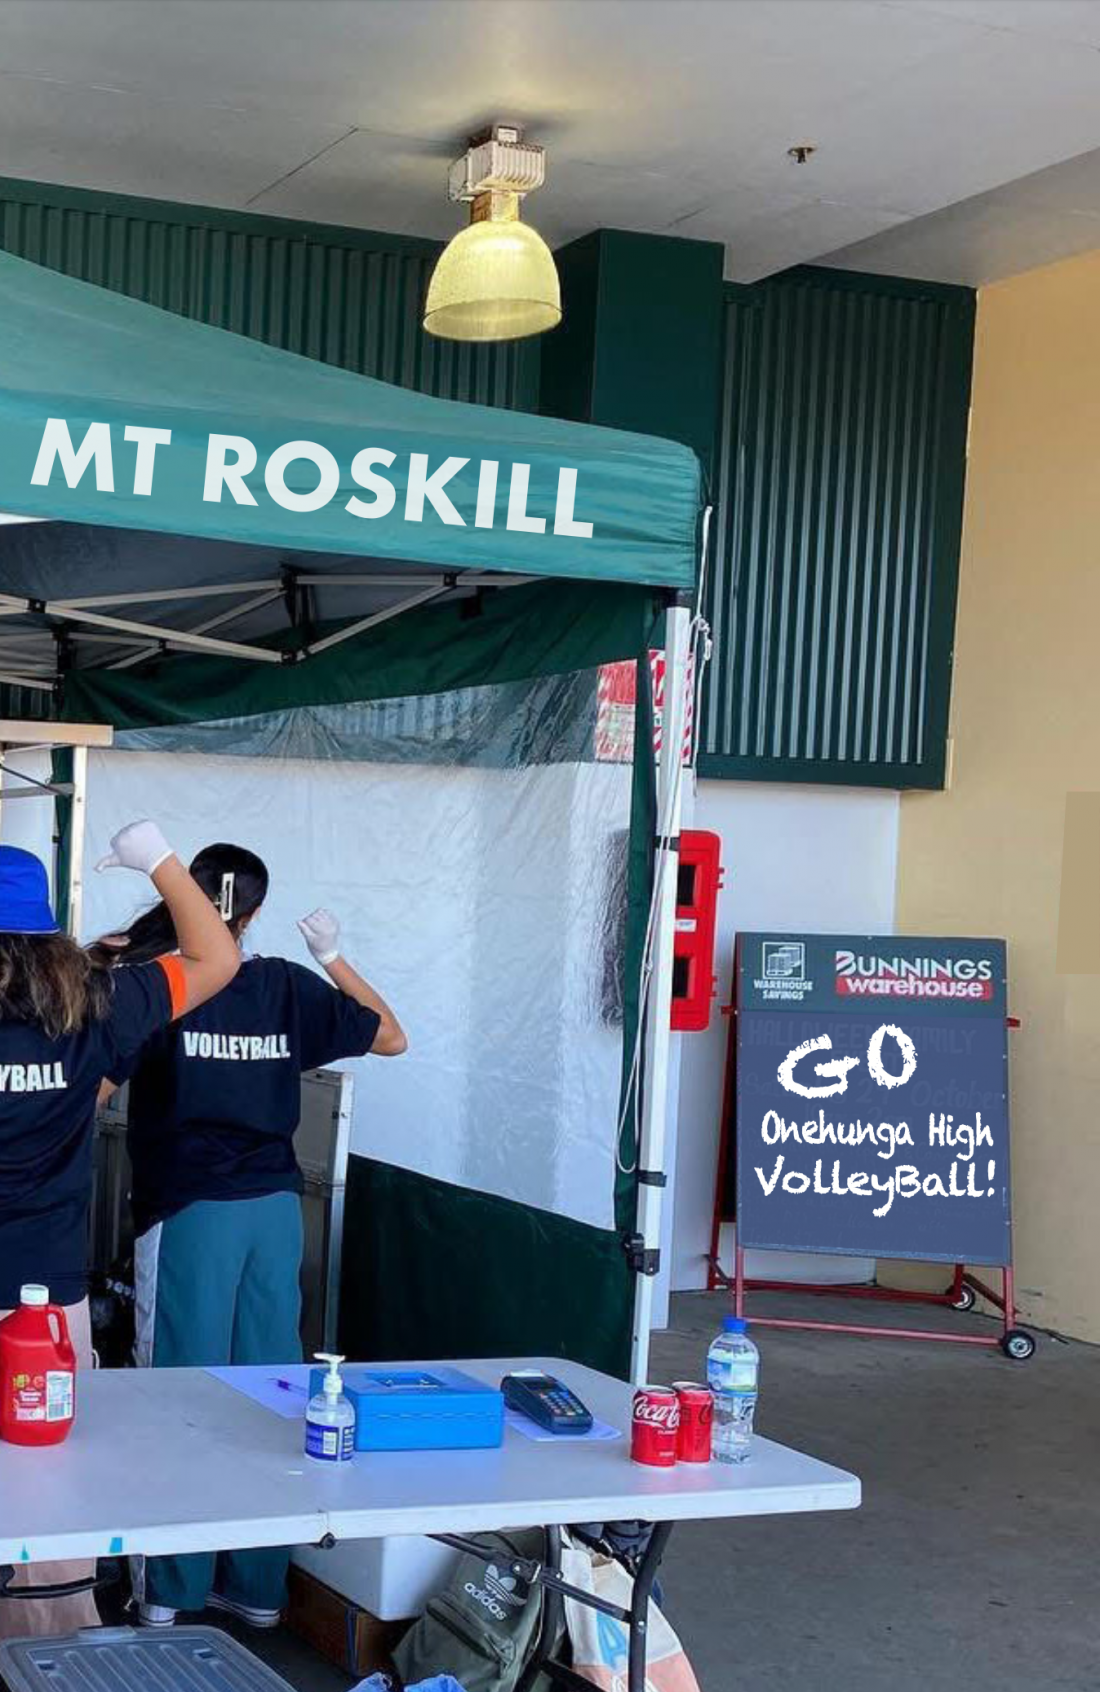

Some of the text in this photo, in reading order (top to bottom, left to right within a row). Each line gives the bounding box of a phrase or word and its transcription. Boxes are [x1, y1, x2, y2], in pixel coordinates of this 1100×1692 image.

[31, 418, 594, 539] MT ROSKILL
[835, 950, 992, 980] BUNNINGS
[753, 979, 813, 991] WAREHOUSE
[762, 990, 804, 1001] SAVINGS
[845, 974, 984, 998] warehouse
[183, 1031, 291, 1060] VOLLEYBALL
[777, 1023, 918, 1099] GO
[761, 1110, 914, 1159] Onehunga
[929, 1112, 995, 1161] High
[464, 1582, 507, 1621] adidas
